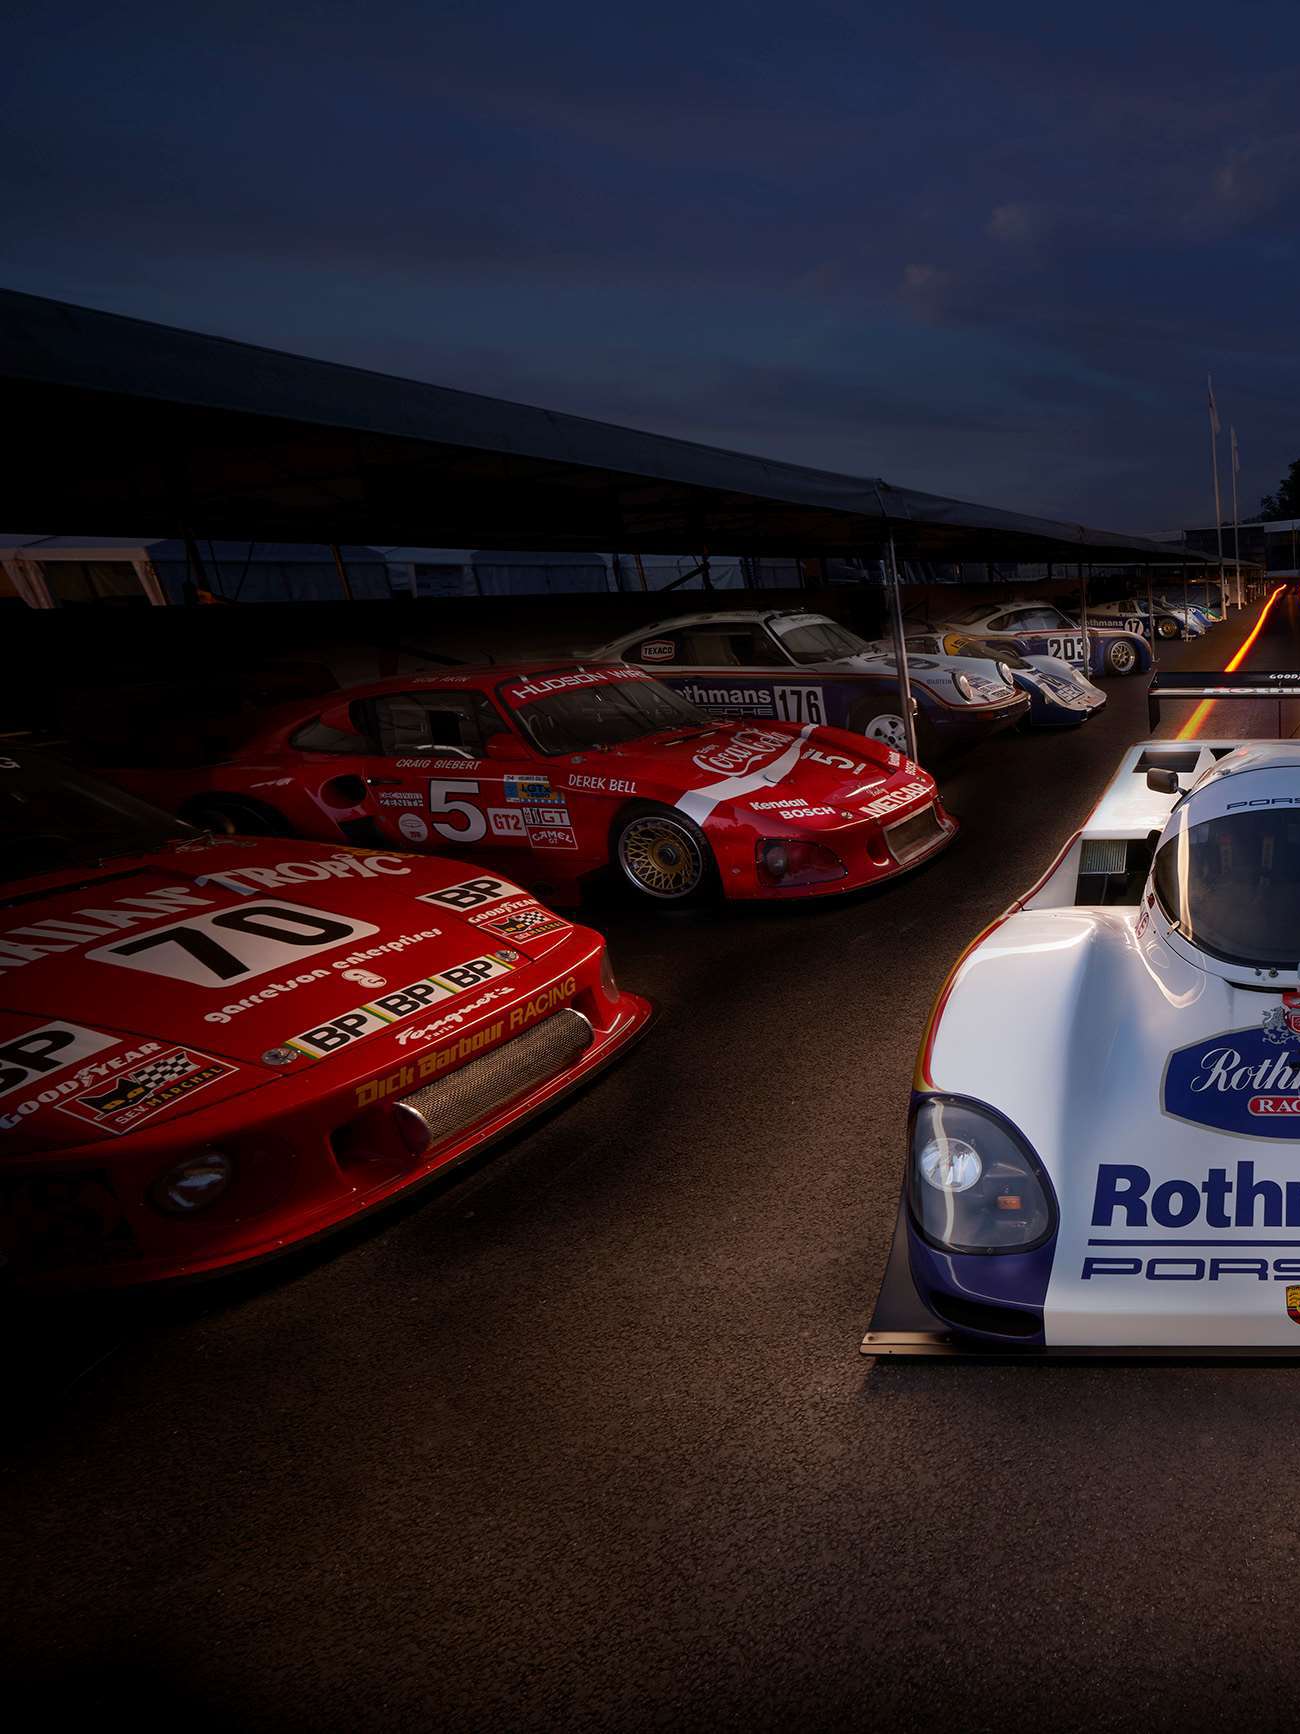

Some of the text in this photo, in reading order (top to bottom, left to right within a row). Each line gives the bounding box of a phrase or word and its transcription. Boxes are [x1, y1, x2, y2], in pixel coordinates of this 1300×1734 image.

[1086, 619, 1123, 627] othmans
[643, 646, 673, 655] TEXACO
[511, 672, 609, 699] HUDSON
[674, 685, 773, 704] thmans
[778, 689, 823, 725] 176
[395, 758, 431, 768] CRAIG
[567, 773, 638, 794] DEREK BELL
[429, 779, 488, 843] 5
[748, 799, 809, 812] Kendall
[778, 806, 836, 820] BOSCH
[493, 814, 522, 830] GT2
[531, 831, 574, 844] CAMEL
[425, 879, 503, 908] BP
[0, 853, 412, 977] AIIAN TROPIC
[108, 906, 355, 980] 70
[203, 968, 333, 1024] garretson
[331, 927, 444, 970] enterprises
[300, 960, 493, 1052] BP BP BP
[356, 976, 576, 1108] Dick Barbour RACING
[0, 1041, 163, 1129] GOODYEAR
